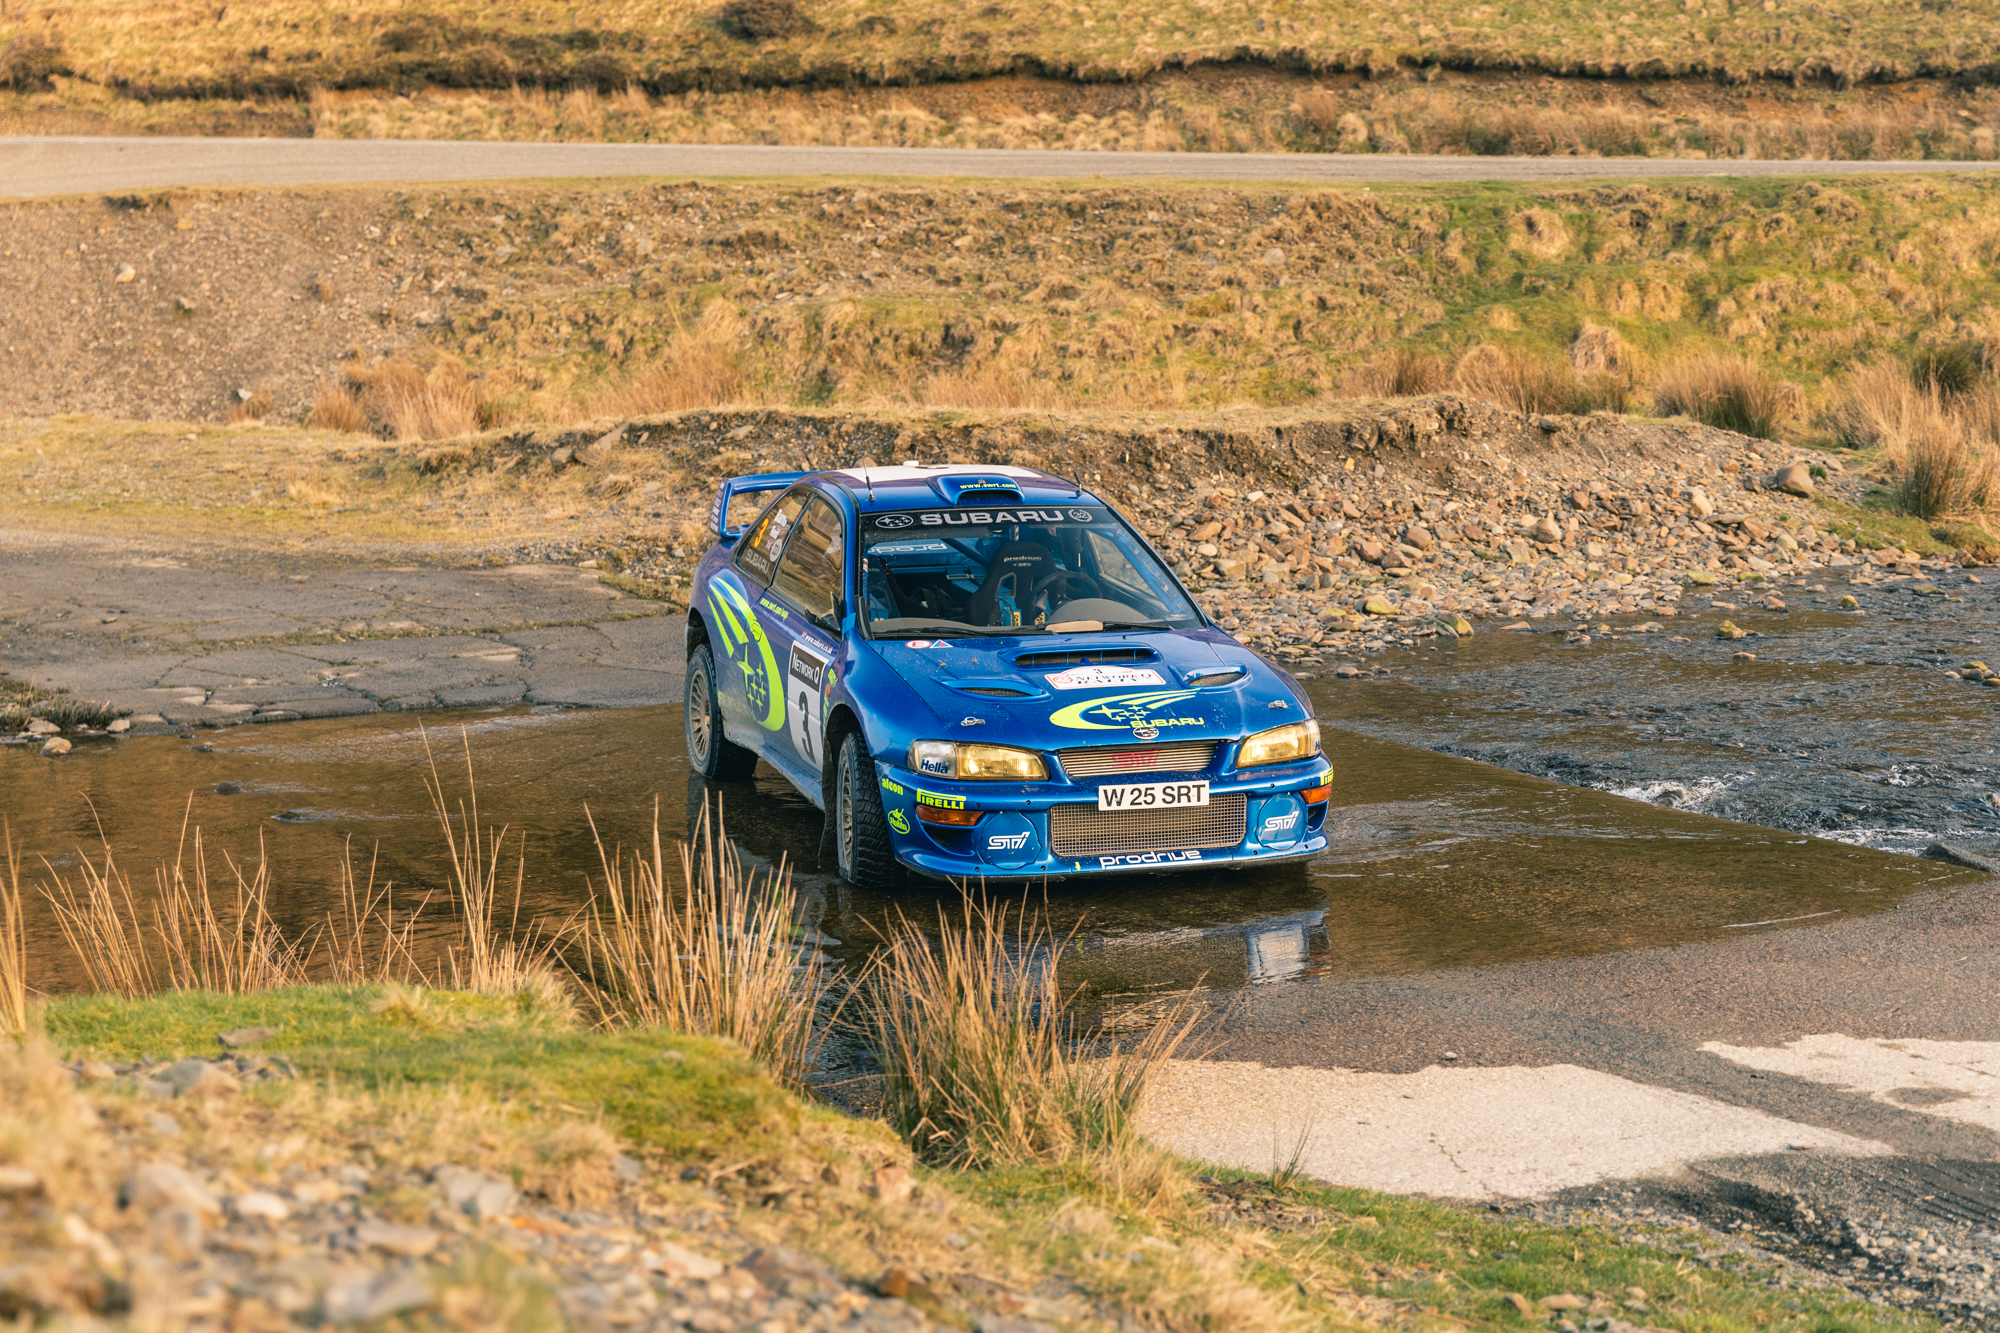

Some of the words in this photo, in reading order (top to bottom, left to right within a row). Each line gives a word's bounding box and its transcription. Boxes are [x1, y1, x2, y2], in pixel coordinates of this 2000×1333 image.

[920, 509, 1065, 526] SUBARU
[754, 518, 769, 548] 3
[745, 549, 770, 575] SUBARU
[813, 666, 820, 684] Q
[799, 691, 817, 764] 3
[1130, 717, 1204, 728] SUBARU
[921, 758, 949, 774] Hella
[881, 777, 904, 796] alcon
[1102, 787, 1126, 807] W
[1129, 787, 1156, 806] 25
[1161, 784, 1206, 805] SRT
[916, 788, 967, 810] PIRELLI
[1099, 850, 1202, 870] prodrive
